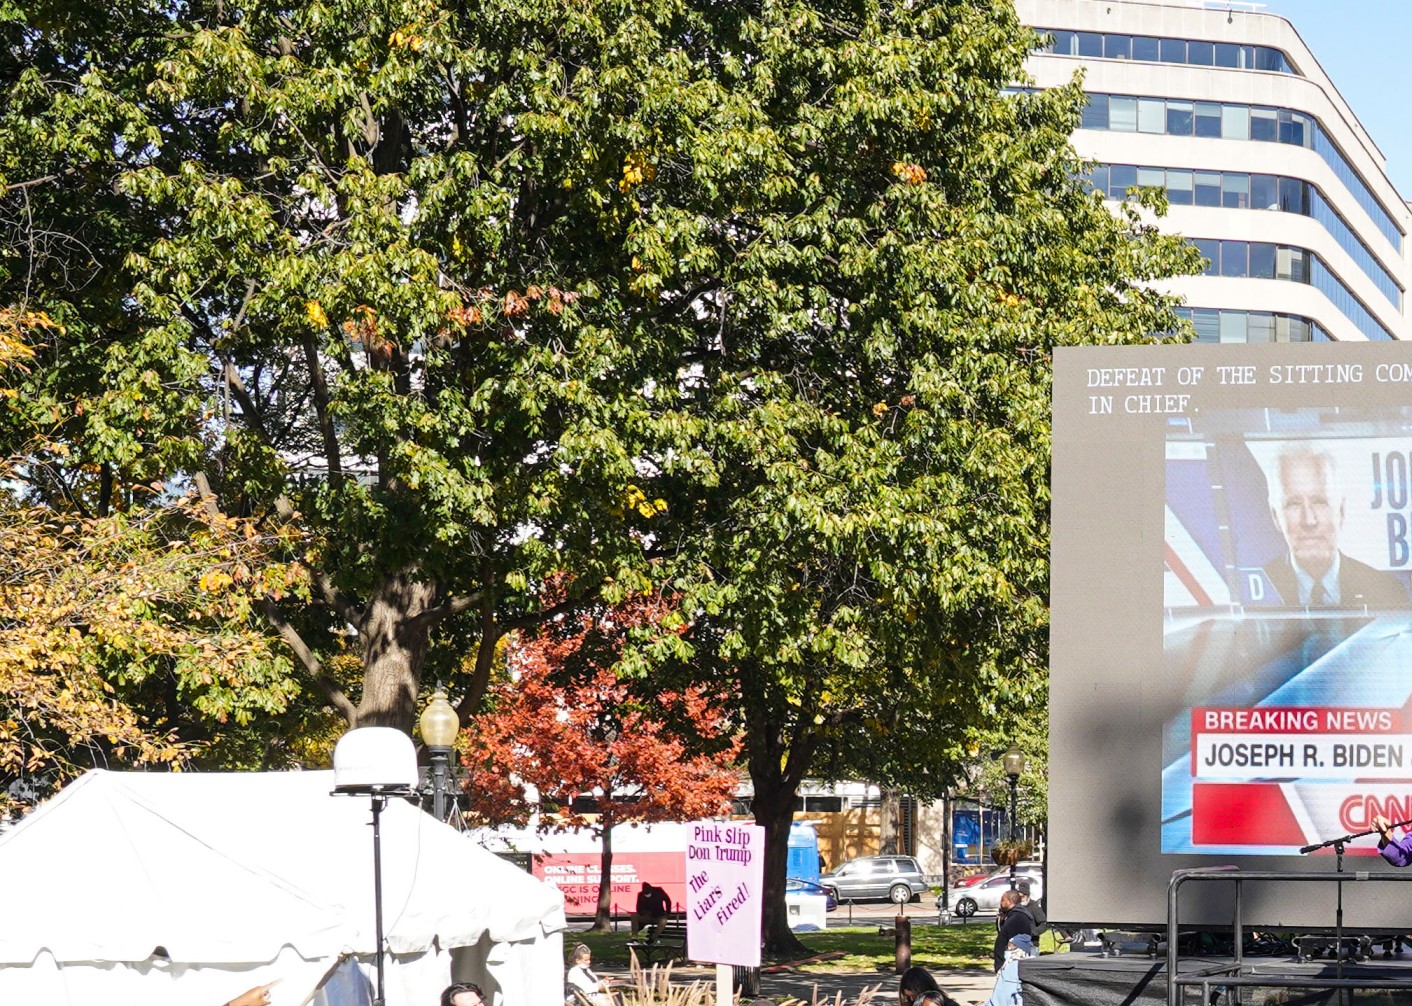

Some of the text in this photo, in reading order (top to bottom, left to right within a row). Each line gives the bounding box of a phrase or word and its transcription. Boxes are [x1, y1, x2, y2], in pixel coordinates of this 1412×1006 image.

[1087, 368, 1166, 387] DEFEAT
[1177, 367, 1204, 386] OF
[1216, 366, 1257, 385] THE
[1269, 364, 1363, 384] SITTING
[1088, 394, 1200, 414] IN CHIEF.
[1248, 573, 1264, 600] D
[1205, 711, 1392, 731] BREAKING NEWS
[1205, 743, 1294, 767] JOSEPH
[1304, 744, 1324, 767] R.
[1333, 744, 1403, 767] BIDEN
[694, 825, 750, 849] Pink Slip
[688, 845, 752, 866] Don Trump
[544, 865, 585, 874] ONLINE
[587, 875, 640, 883] SUPORT.
[689, 870, 709, 894] The
[716, 882, 750, 926] Fired!
